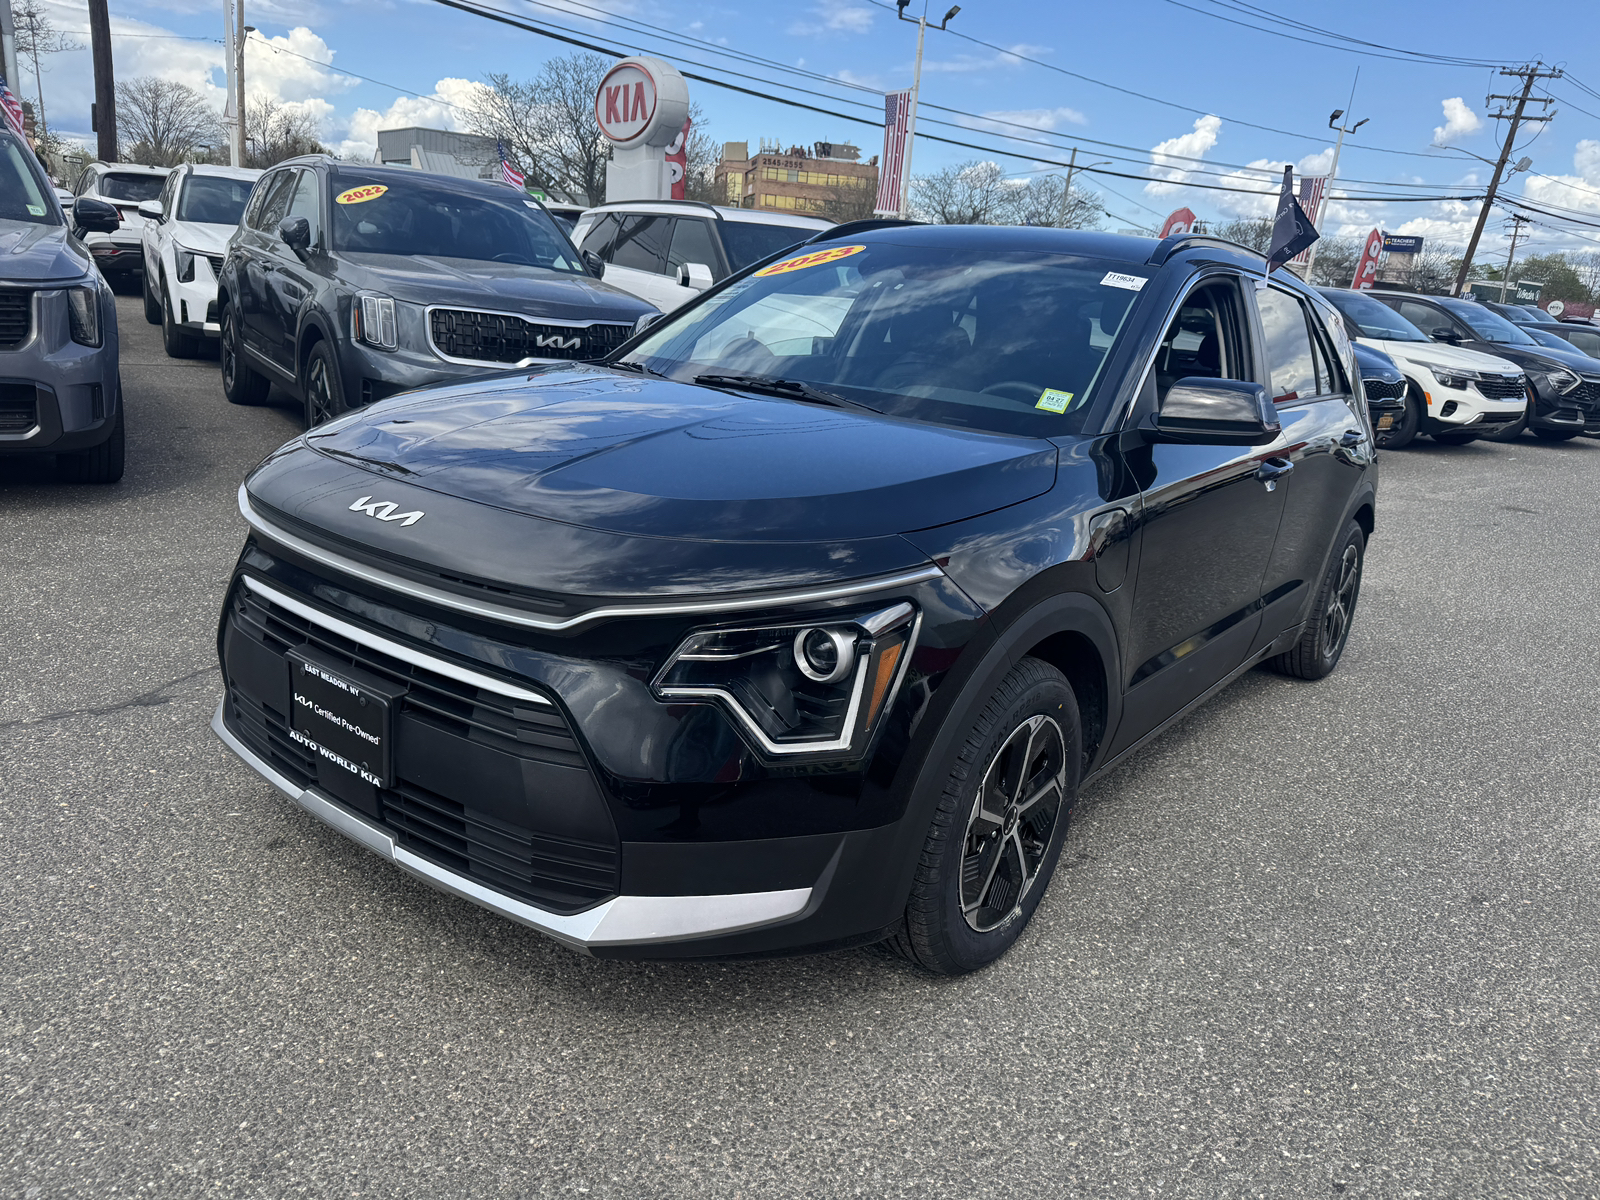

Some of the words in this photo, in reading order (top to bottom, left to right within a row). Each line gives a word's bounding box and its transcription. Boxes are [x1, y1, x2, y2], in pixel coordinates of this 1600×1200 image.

[605, 81, 648, 124] KIA
[762, 157, 803, 169] 2545-2555
[343, 186, 384, 202] 2022
[763, 247, 855, 275] 2023
[536, 334, 581, 350] KIA
[348, 495, 426, 527] KIA
[304, 663, 320, 677] EAST
[349, 686, 360, 697] NY
[294, 692, 313, 709] KIA
[314, 704, 341, 726] Certified
[289, 731, 317, 751] AUTO
[319, 747, 358, 775] WORLD
[360, 770, 381, 788] KIA
